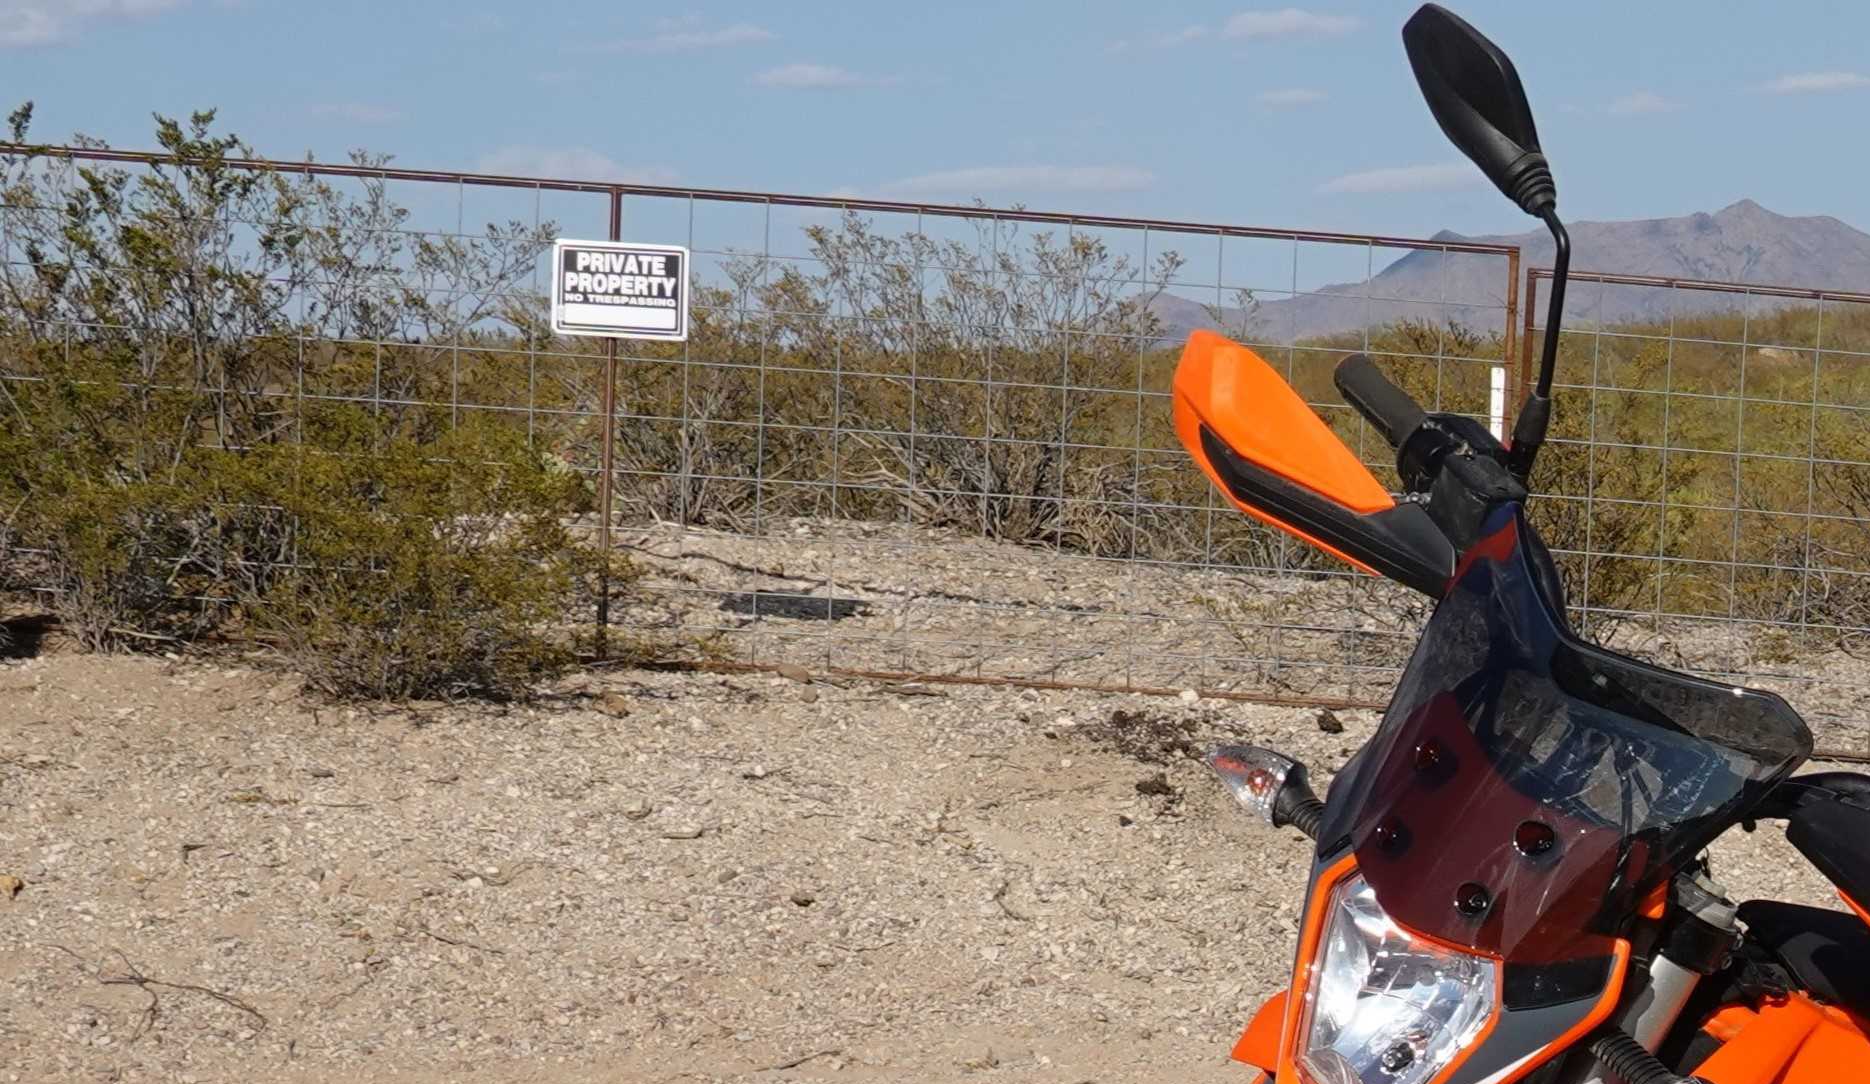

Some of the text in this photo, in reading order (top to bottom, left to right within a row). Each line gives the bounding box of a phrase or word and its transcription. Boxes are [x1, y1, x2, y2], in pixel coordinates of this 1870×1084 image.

[576, 251, 666, 276] PRIVATE
[564, 271, 676, 297] PROPERTY
[564, 292, 676, 307] NO TRESPASSING
